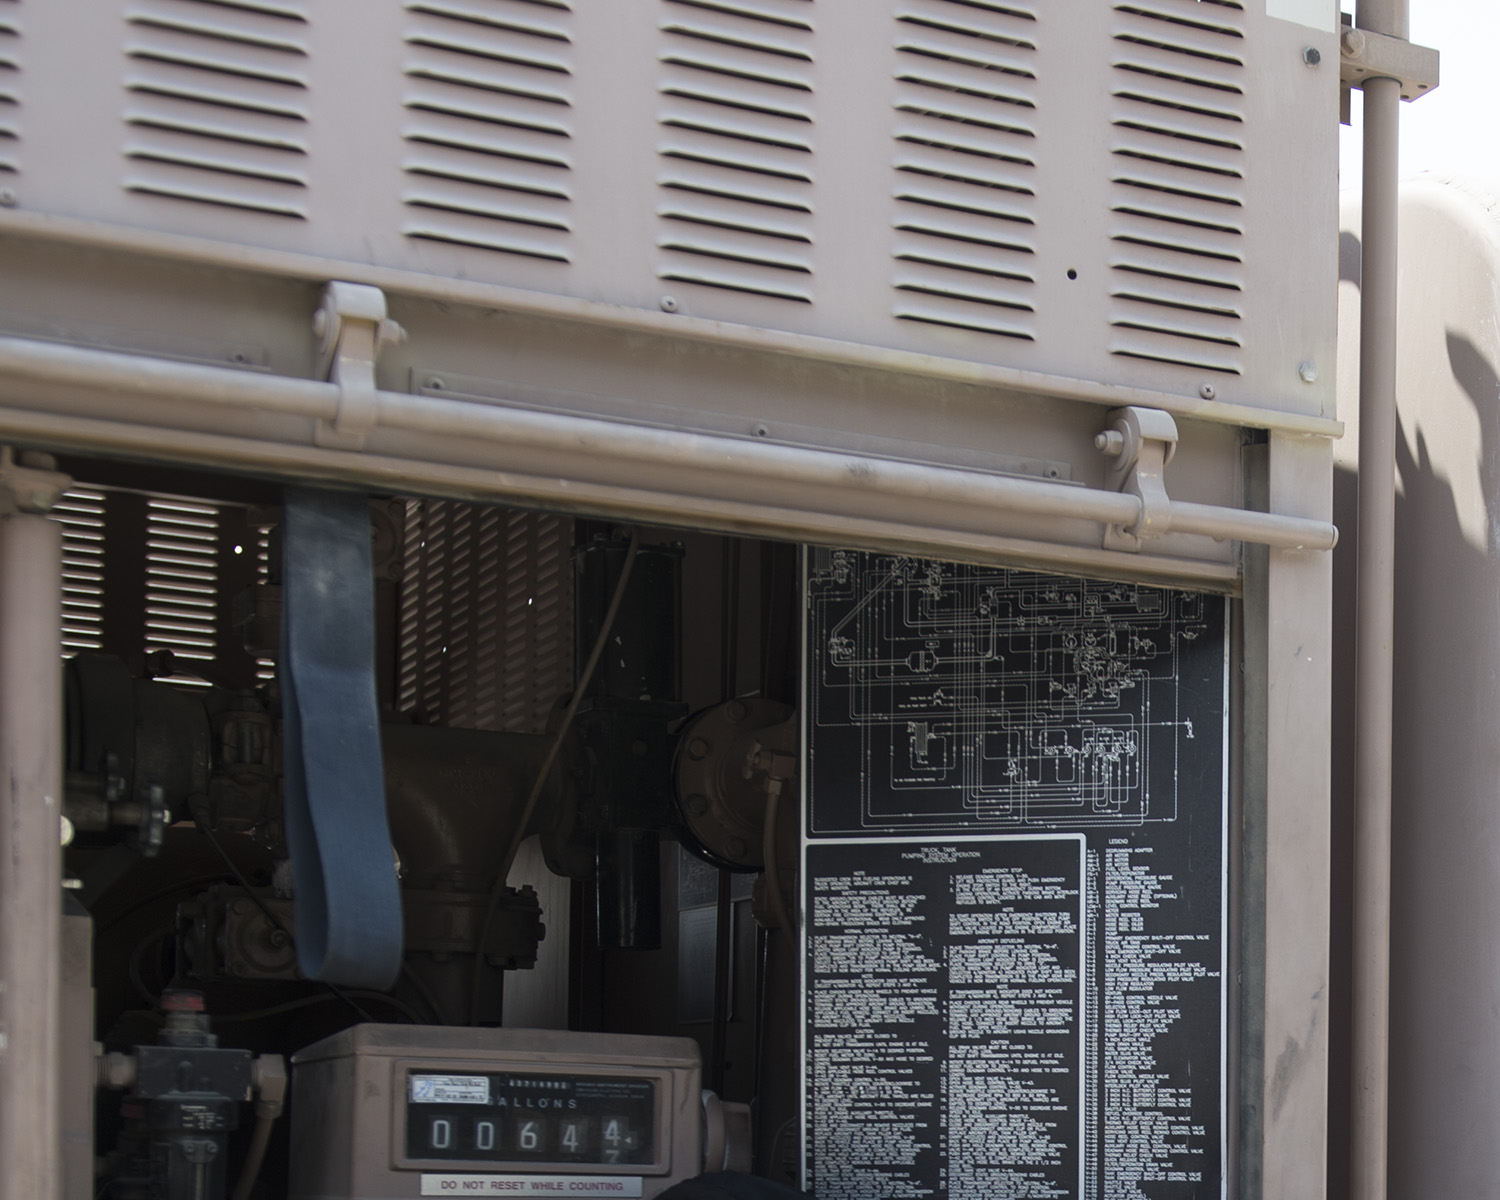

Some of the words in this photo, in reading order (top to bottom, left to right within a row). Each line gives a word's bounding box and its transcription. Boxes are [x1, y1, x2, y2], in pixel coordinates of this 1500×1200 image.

[441, 1180, 457, 1190] DO
[463, 1181, 485, 1190] NOT
[491, 1181, 526, 1191] RESET
[531, 1182, 564, 1191] WHILE
[569, 1182, 624, 1192] COUNTING
